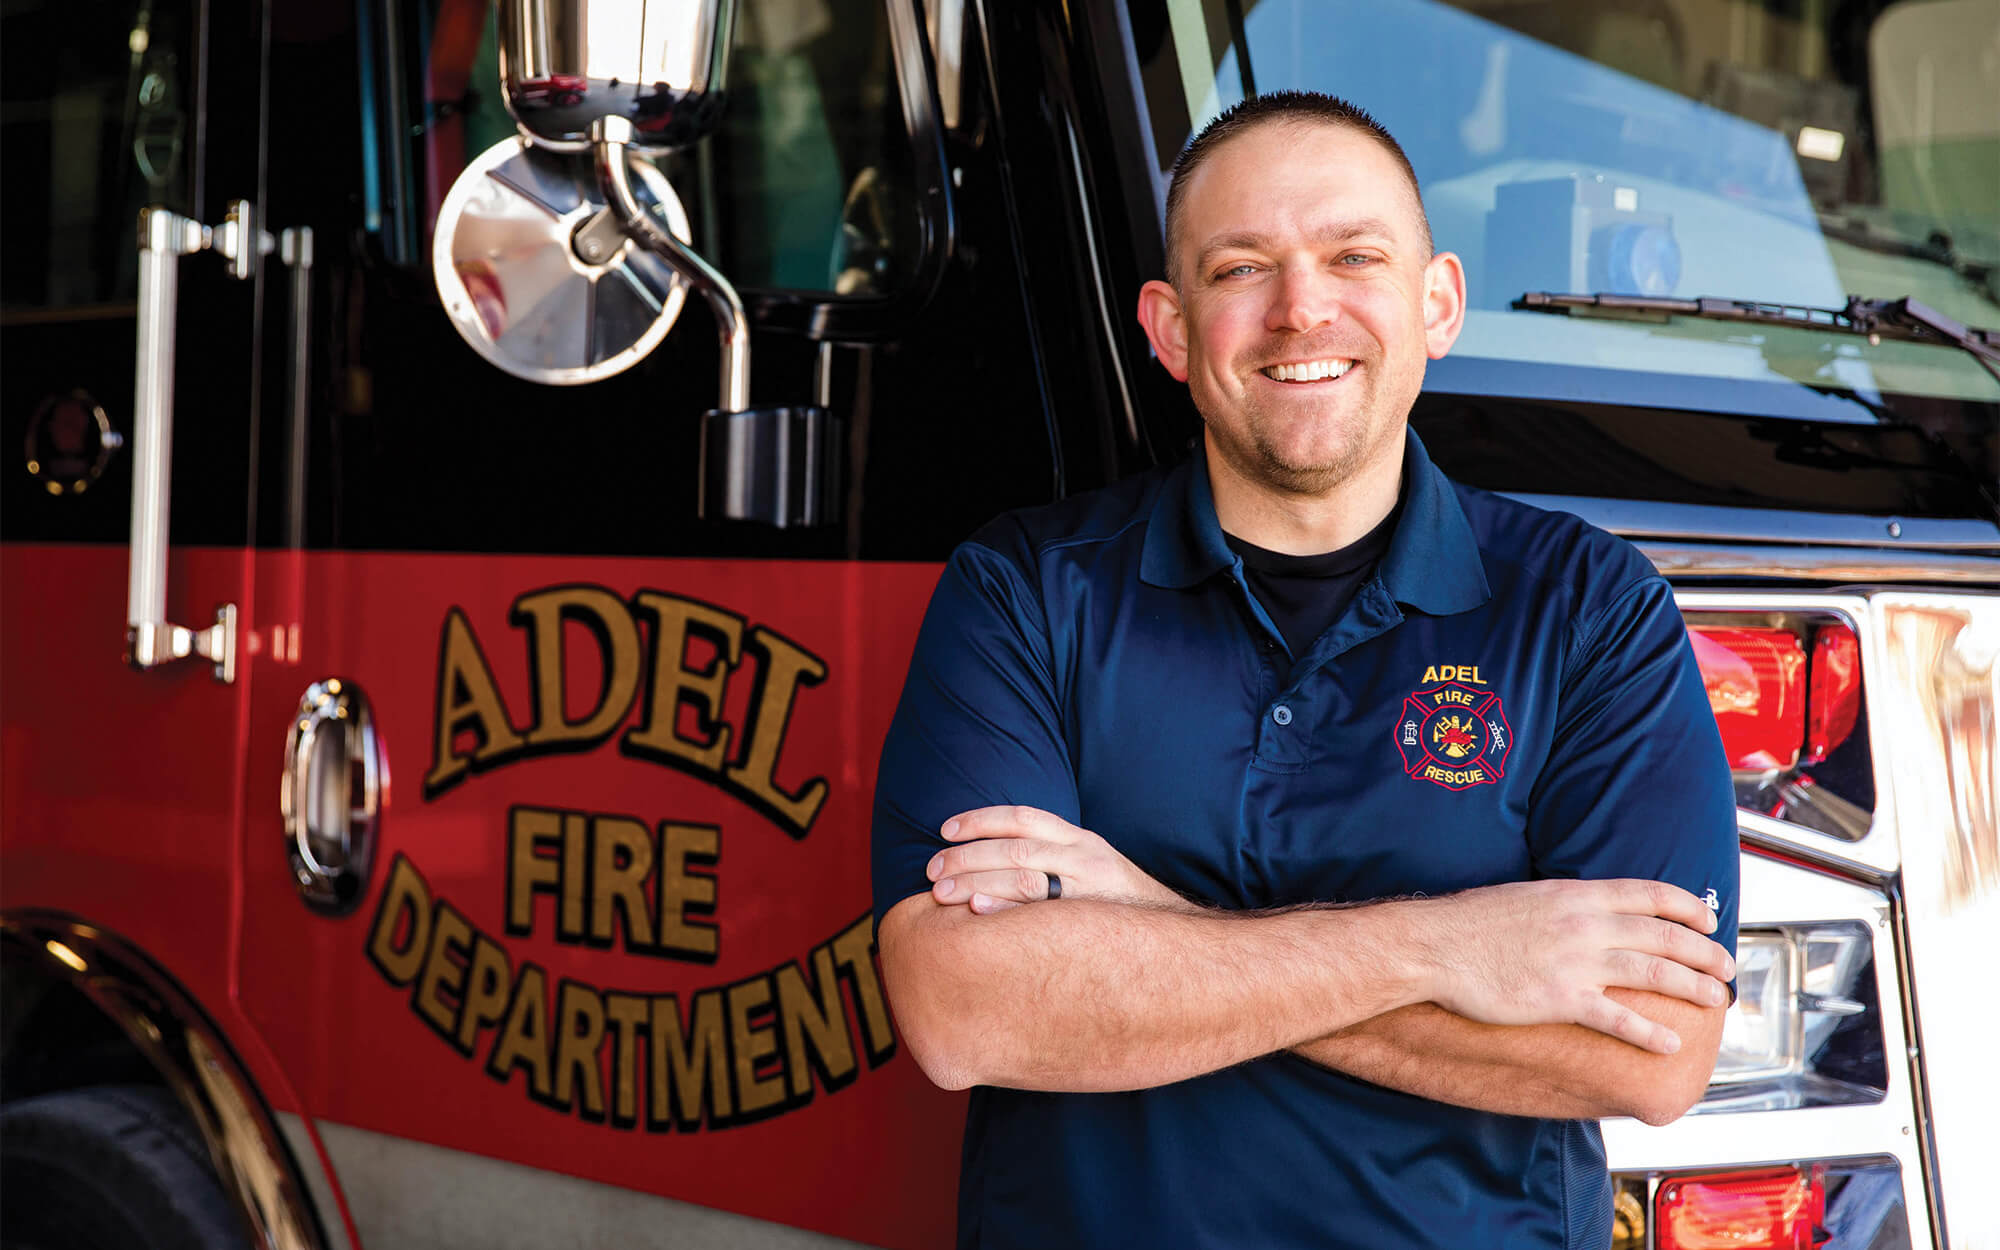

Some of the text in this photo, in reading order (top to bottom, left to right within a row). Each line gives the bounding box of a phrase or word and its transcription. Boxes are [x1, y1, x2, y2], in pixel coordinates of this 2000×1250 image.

[424, 582, 828, 839] ADEL
[1421, 665, 1487, 684] ADEL
[1434, 690, 1474, 706] FIRE
[1424, 765, 1485, 784] RESCUE
[506, 805, 720, 963] FIRE
[365, 852, 898, 1132] DEPARTMENT
